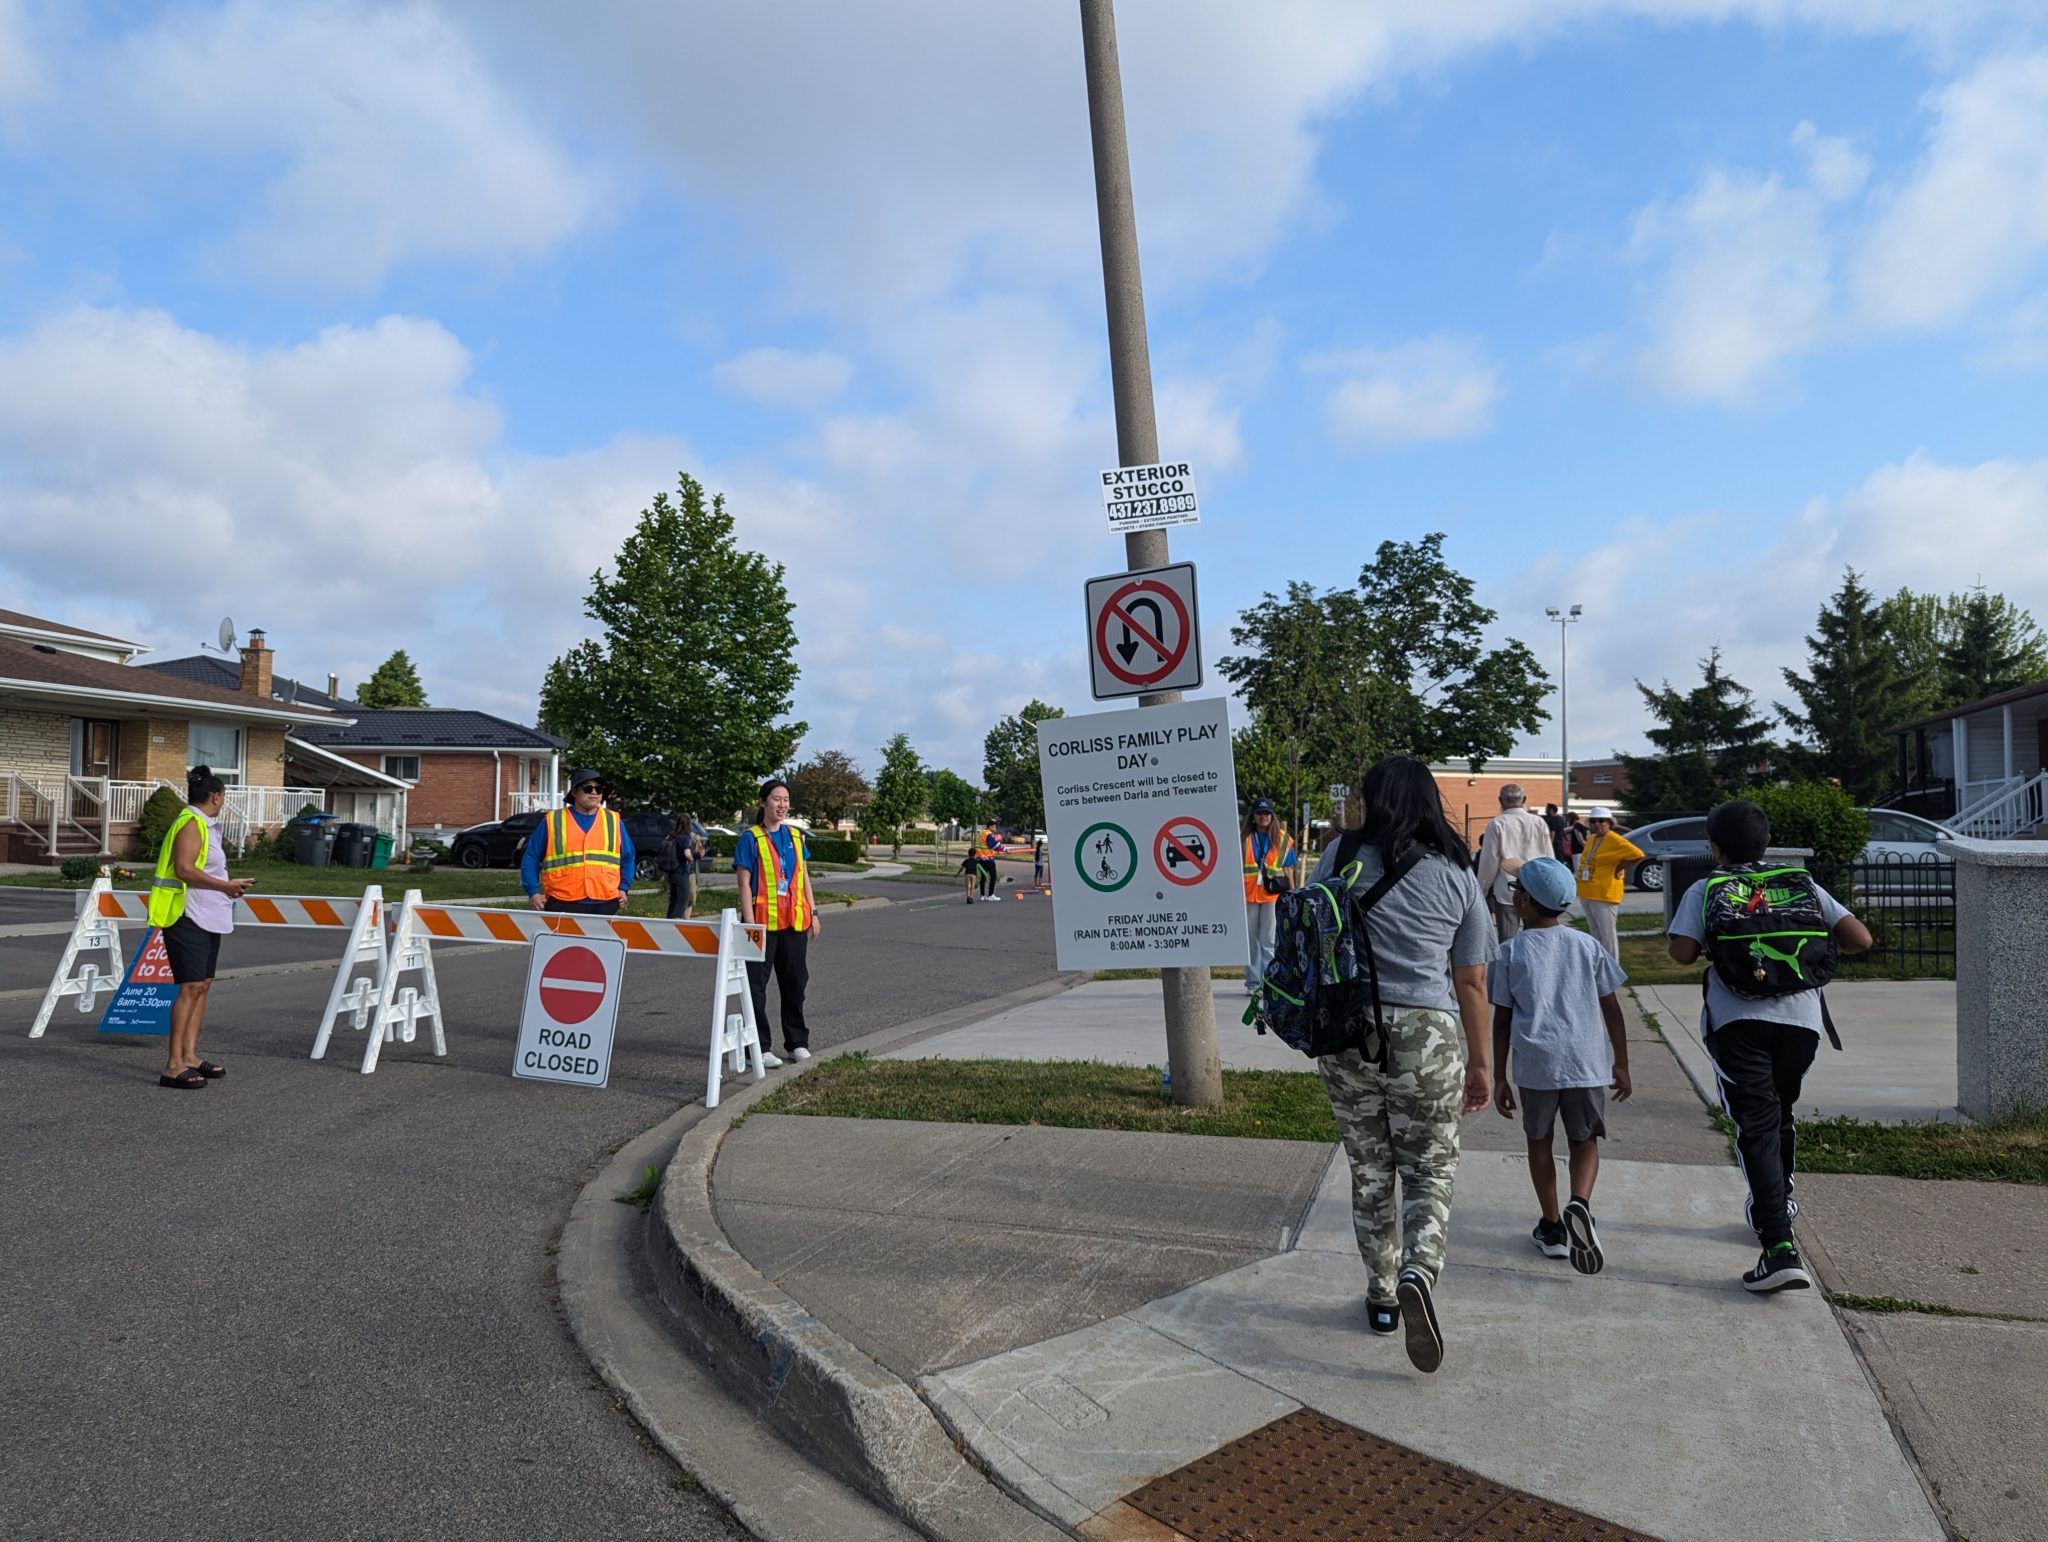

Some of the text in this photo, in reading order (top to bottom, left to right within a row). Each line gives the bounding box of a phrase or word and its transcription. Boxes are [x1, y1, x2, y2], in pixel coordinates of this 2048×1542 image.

[1102, 464, 1190, 485] EXTERIOR
[1113, 480, 1184, 500] STUCCO
[1109, 495, 1195, 519] 437.237.8989
[1048, 724, 1218, 757] CORLISS FAMILY PLAY
[1118, 753, 1148, 770] DAY
[1057, 771, 1218, 794] Corliss Crescent will be closed to
[1060, 784, 1218, 806] cars between Darla and Teewater
[1332, 787, 1347, 798] 30
[1108, 912, 1188, 925] FRIDAY JUNE 20
[746, 930, 760, 942] 18
[1074, 923, 1227, 942] (RAIN DATE: MONDAY JUNE 23)
[89, 936, 100, 947] 13
[1110, 940, 1145, 950] 8:00AM
[1154, 938, 1190, 949] 3:30PM
[138, 962, 155, 977] to
[407, 956, 415, 967] 11
[122, 987, 157, 996] June 20
[117, 998, 172, 1008] 8am-3:30pm
[538, 1028, 591, 1049] ROAD
[524, 1051, 599, 1075] CLOSED
